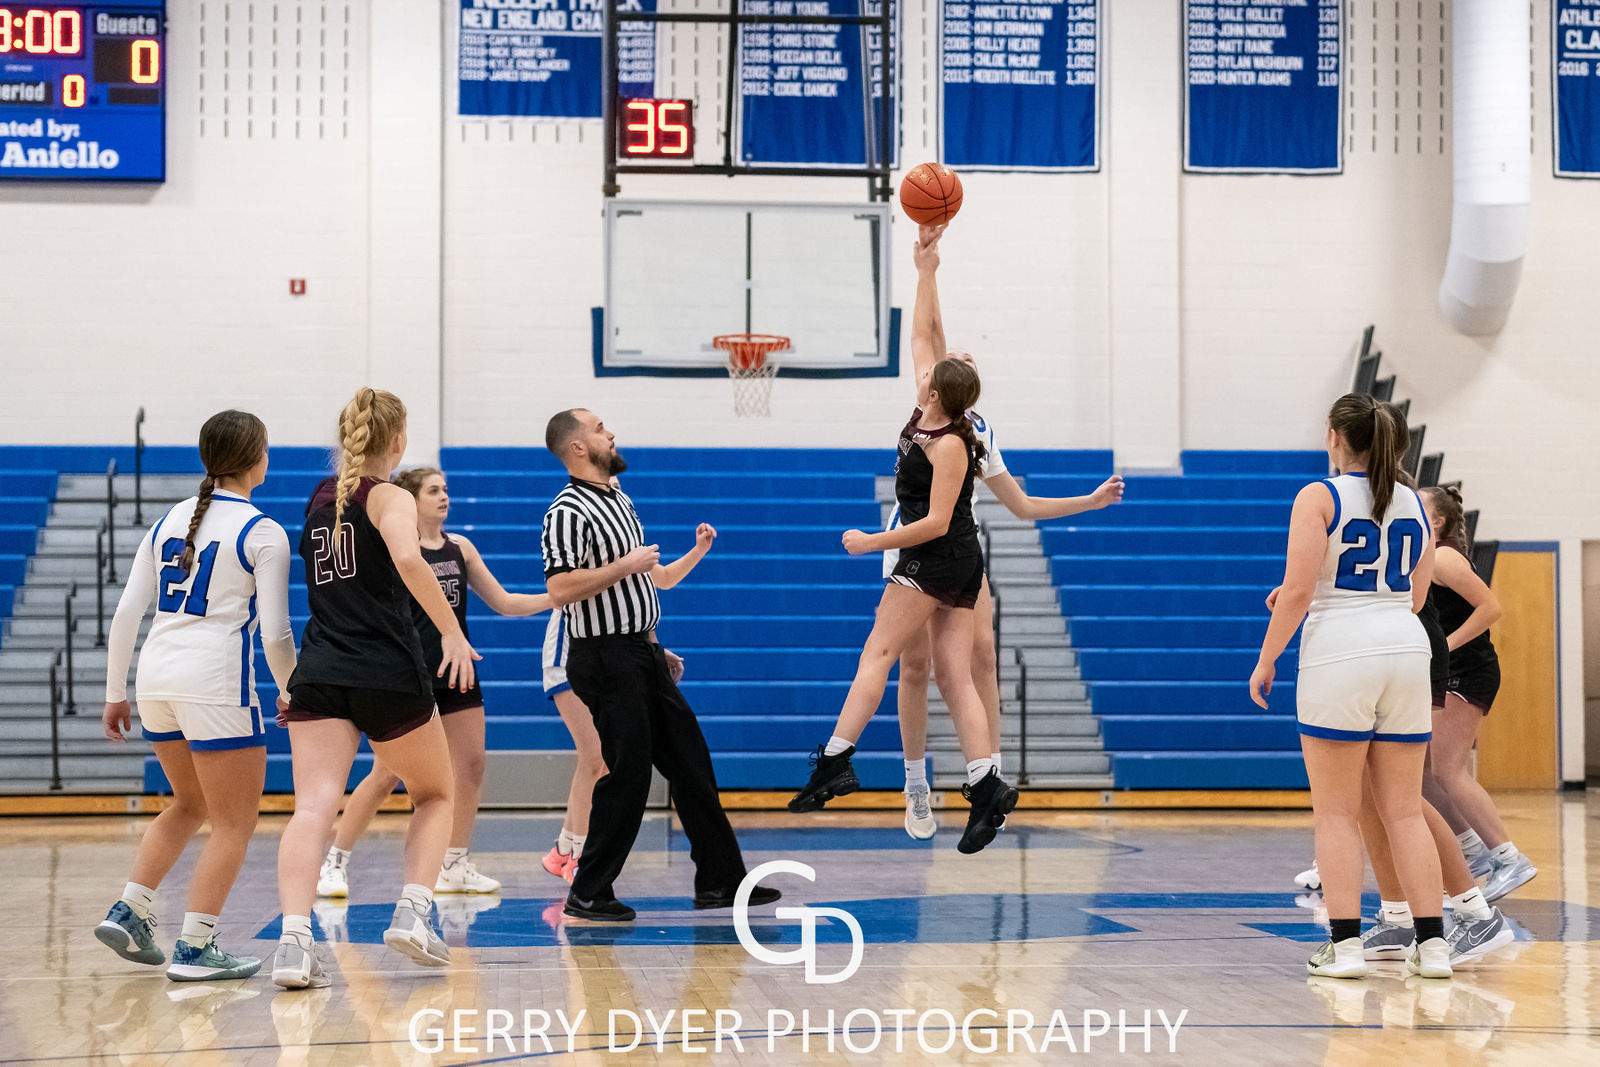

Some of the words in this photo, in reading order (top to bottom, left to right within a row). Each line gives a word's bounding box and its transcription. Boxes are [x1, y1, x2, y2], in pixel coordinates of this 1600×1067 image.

[97, 13, 157, 34] Guests
[462, 8, 493, 29] NEW
[497, 9, 567, 30] ENGLAND
[1019, 6, 1053, 20] FLYNN
[803, 34, 837, 48] STONE
[1007, 38, 1040, 52] HEATH
[131, 40, 159, 84] 0
[0, 82, 46, 102] eriod
[62, 74, 86, 108] 0
[47, 118, 81, 142] by:
[626, 101, 689, 154] 35
[0, 141, 119, 169] Aniello
[311, 522, 357, 586] 20
[1334, 517, 1423, 592] 20
[158, 536, 220, 618] 21
